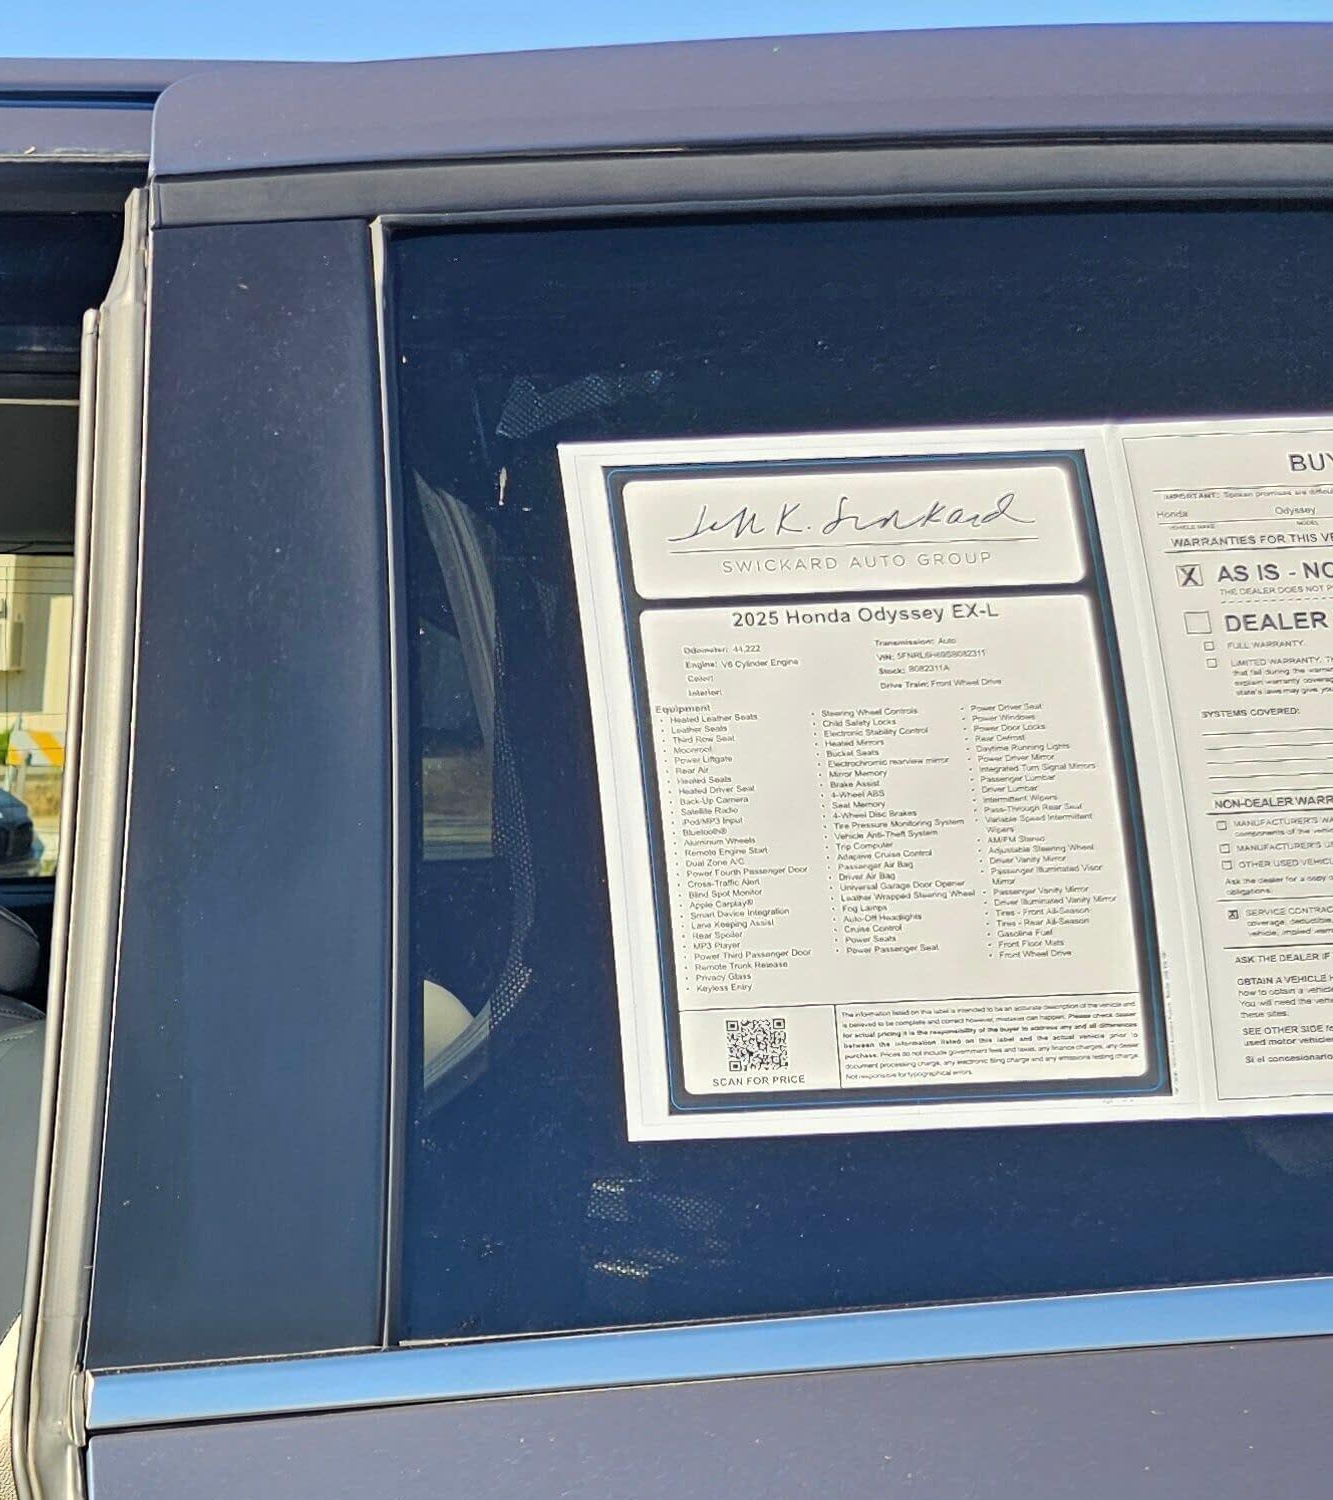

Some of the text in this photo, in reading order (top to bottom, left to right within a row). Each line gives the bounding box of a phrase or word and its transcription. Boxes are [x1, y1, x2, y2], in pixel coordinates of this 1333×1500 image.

[1157, 510, 1188, 518] Honda
[1275, 506, 1316, 515] Odyssey
[1172, 535, 1256, 547] WARRANTIES
[1260, 535, 1285, 544] FOR
[1290, 533, 1317, 543] THIS
[722, 552, 991, 574] SWICKARD AUTO GROUP
[1217, 565, 1249, 582] AS
[1258, 563, 1280, 580] IS
[1303, 562, 1333, 579] NO
[1240, 587, 1275, 595] DEALER
[1278, 586, 1303, 594] DOES
[1306, 585, 1324, 593] NOT
[733, 602, 999, 627] 2025 Honda Odyssey EX-L
[1225, 611, 1329, 632] DEALER
[735, 660, 768, 669] Cylinder
[771, 658, 799, 667] Engine
[1230, 659, 1266, 667] LIMITED
[655, 704, 710, 715] Equipment
[1201, 707, 1300, 718] SYSTEMS COVERED:
[670, 715, 700, 723] Heated
[701, 714, 732, 722] Leather
[1214, 797, 1293, 809] NON-DEALER
[685, 848, 717, 856] Remote
[718, 847, 747, 857] Engine
[1239, 859, 1299, 868] OTHER USED
[687, 869, 713, 877] Power
[714, 868, 741, 876] Fourth
[742, 867, 786, 877] Passenger
[689, 888, 762, 899] Blind Spot Monitor
[690, 901, 714, 910] Apple
[690, 908, 790, 919] Smart Device Integration
[1245, 908, 1285, 916] SERVICE
[1235, 956, 1255, 964] ASK
[1237, 978, 1273, 986] OBTAIN
[1285, 975, 1326, 983] VEHICLE
[1264, 1026, 1298, 1034] OTHER
[713, 1075, 805, 1086] SCAN FOR PRICE
